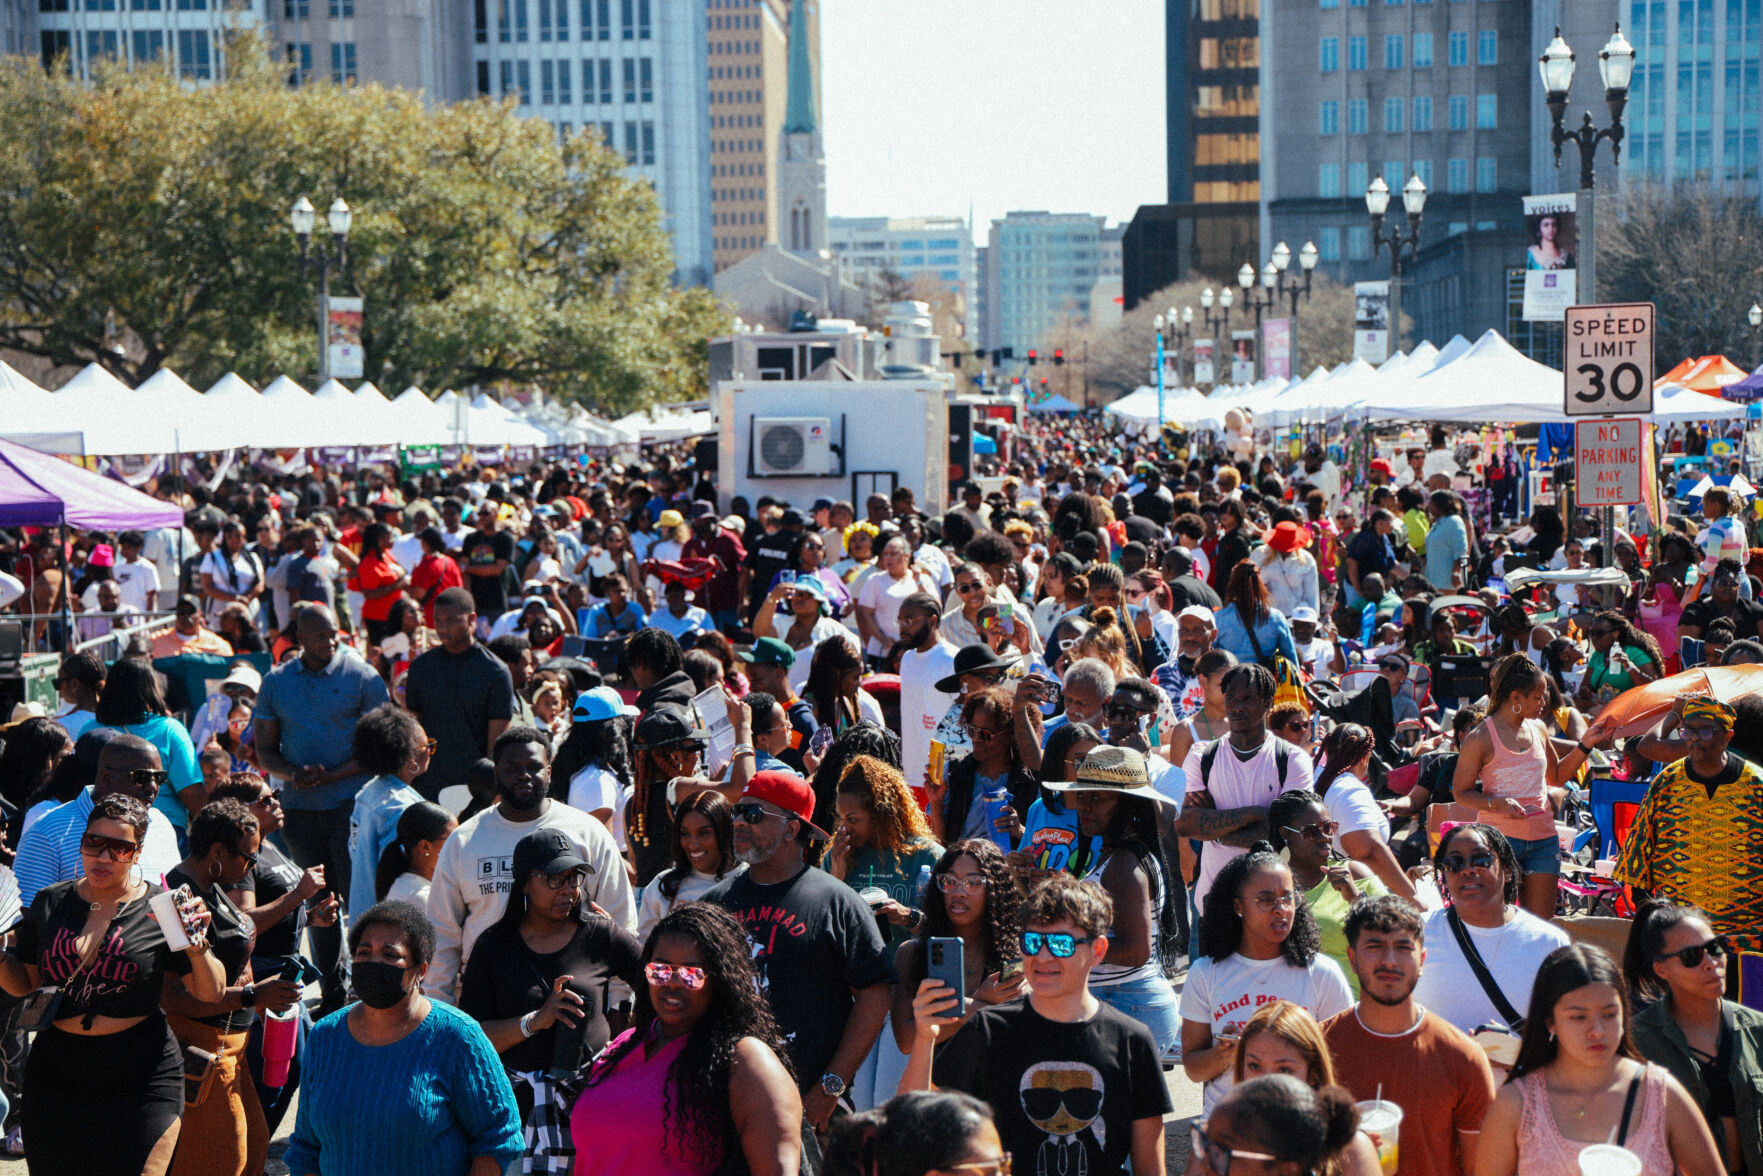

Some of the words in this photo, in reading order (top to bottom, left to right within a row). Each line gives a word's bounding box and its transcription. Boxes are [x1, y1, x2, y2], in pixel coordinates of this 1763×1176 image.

[1573, 318, 1646, 336] SPEED
[1580, 341, 1637, 358] LIMIT
[1574, 362, 1644, 403] 30
[1598, 425, 1620, 442] NO
[1582, 447, 1637, 465] PARKING
[1597, 469, 1621, 483] ANY
[1595, 487, 1624, 500] TIME
[479, 882, 495, 896] THE
[1213, 993, 1251, 1022] kind
